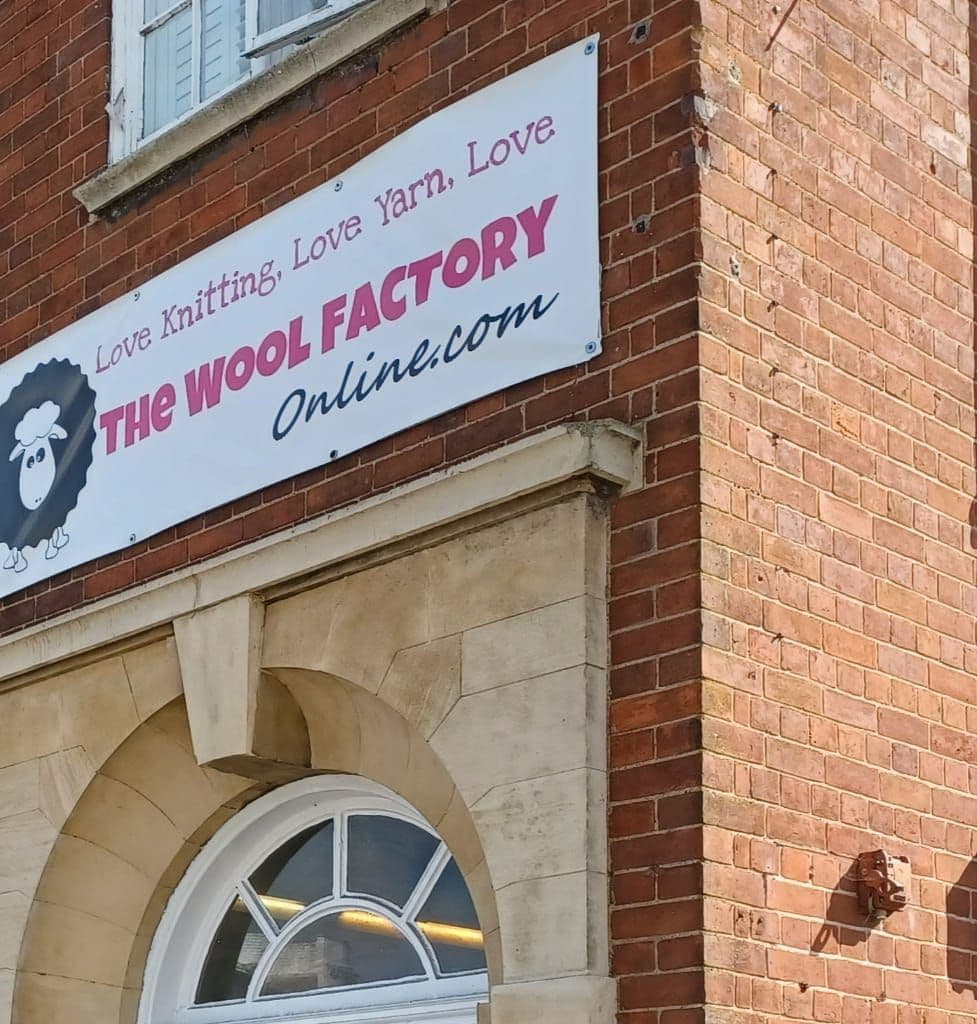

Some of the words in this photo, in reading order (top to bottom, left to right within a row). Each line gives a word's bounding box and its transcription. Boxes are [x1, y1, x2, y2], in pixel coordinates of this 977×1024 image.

[96, 327, 152, 374] Love
[160, 259, 282, 340] Knitting,
[292, 215, 362, 270] Love
[374, 168, 455, 226] Yarn,
[467, 115, 556, 177] Love
[184, 315, 312, 417] WOOL
[321, 194, 559, 354] FACTORY
[272, 292, 560, 441] Online.com
